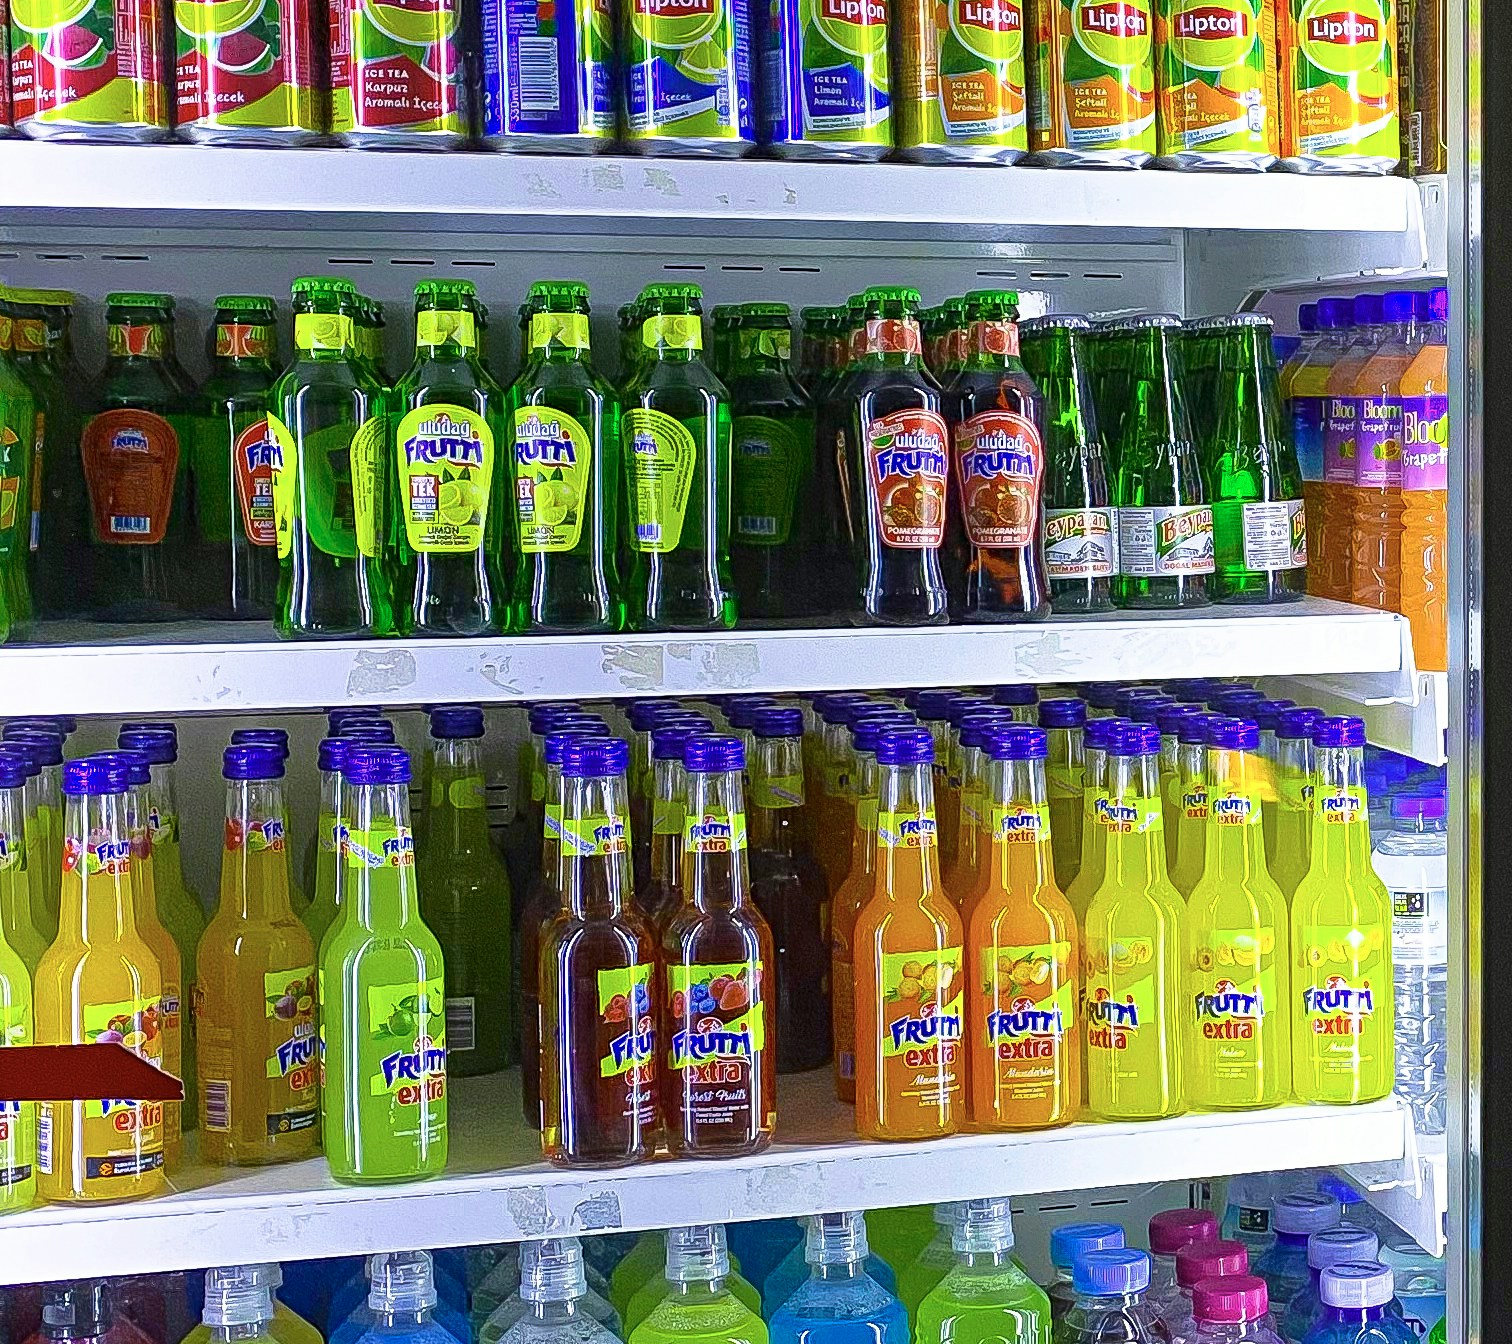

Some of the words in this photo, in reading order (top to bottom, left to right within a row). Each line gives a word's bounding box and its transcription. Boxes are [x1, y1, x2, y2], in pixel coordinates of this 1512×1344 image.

[965, 0, 1020, 27] Lipton
[1088, 5, 1145, 36] Lipton
[1179, 10, 1242, 37] Lipton
[1313, 16, 1375, 42] Lipton
[365, 69, 383, 78] ICE
[387, 69, 409, 78] TEA
[365, 81, 408, 95] Karpuz
[815, 85, 842, 95] Limon
[365, 96, 409, 108] Aromalı
[412, 483, 437, 496] TEK
[1217, 814, 1244, 825] extra
[1327, 812, 1355, 823] extra
[695, 838, 727, 853] extra
[1006, 830, 1036, 843] extra
[1203, 1021, 1252, 1039] extra
[1313, 1015, 1362, 1035] extra
[1089, 1028, 1127, 1050] extra
[905, 1044, 955, 1066] extra
[999, 1039, 1053, 1059] extra
[682, 1061, 741, 1083] extra
[115, 1112, 161, 1133] extra
